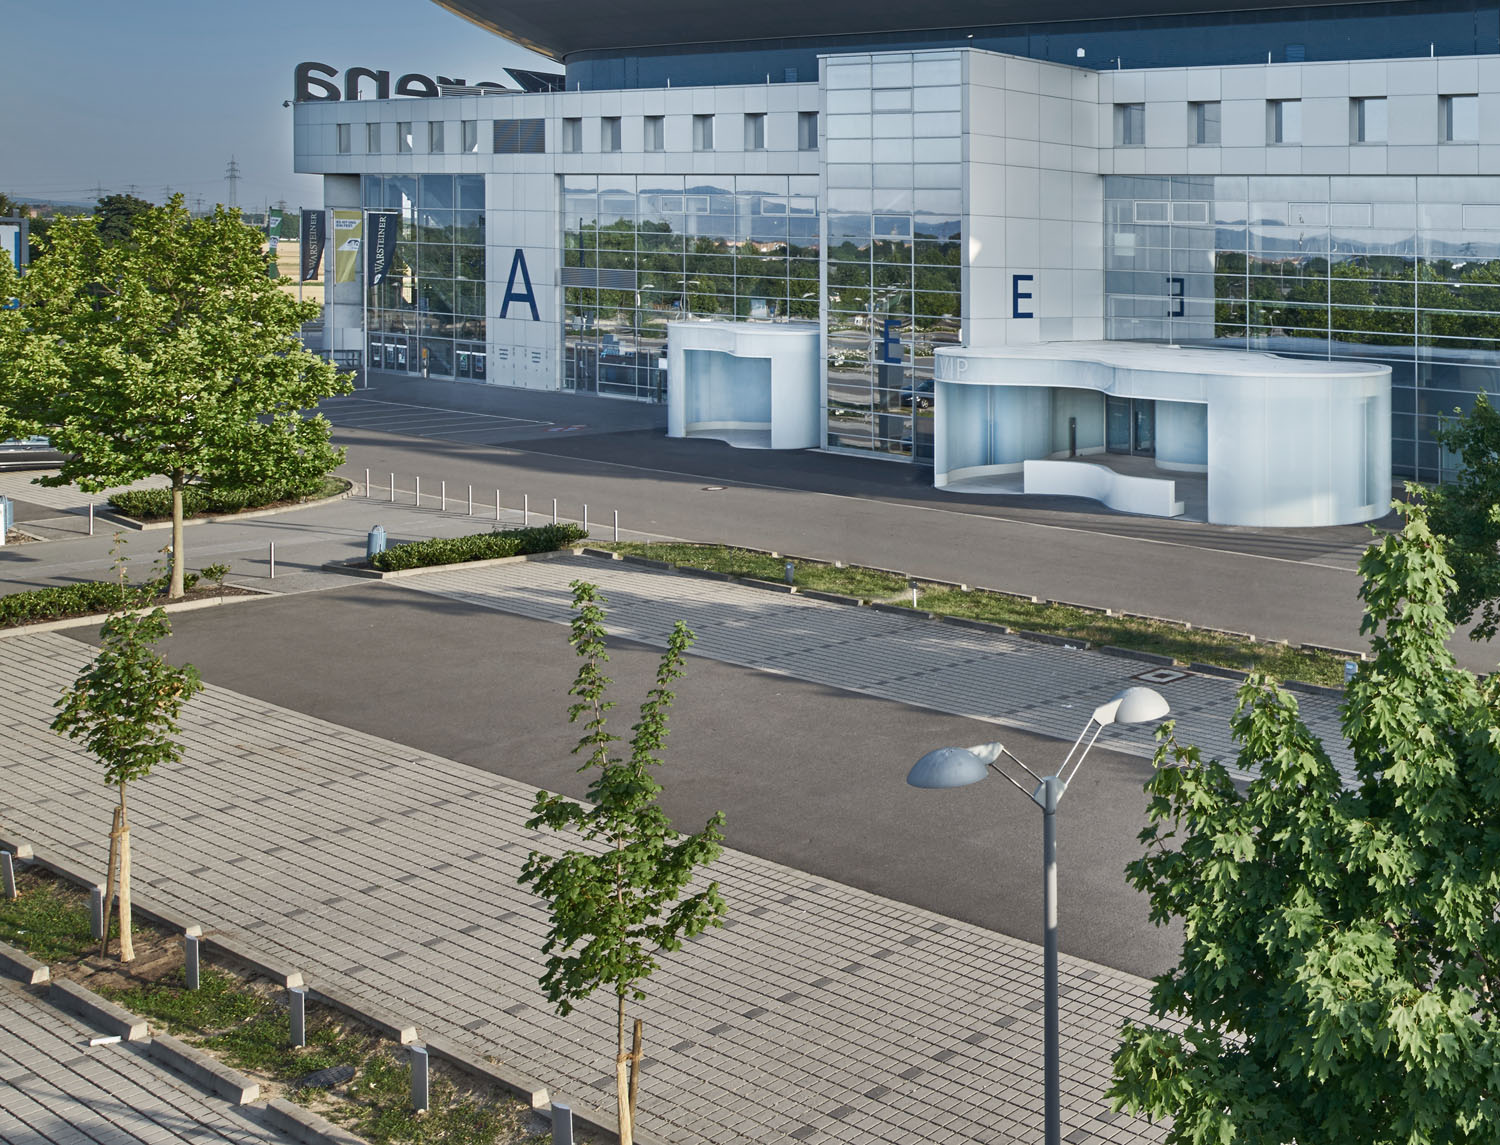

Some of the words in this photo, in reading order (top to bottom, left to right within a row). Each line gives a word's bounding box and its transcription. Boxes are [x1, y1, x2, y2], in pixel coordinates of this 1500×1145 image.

[309, 212, 318, 269] WARSTEINER
[374, 216, 387, 273] WARSTEINER
[500, 248, 540, 321] A
[1012, 274, 1034, 319] E
[940, 357, 968, 380] VIP
